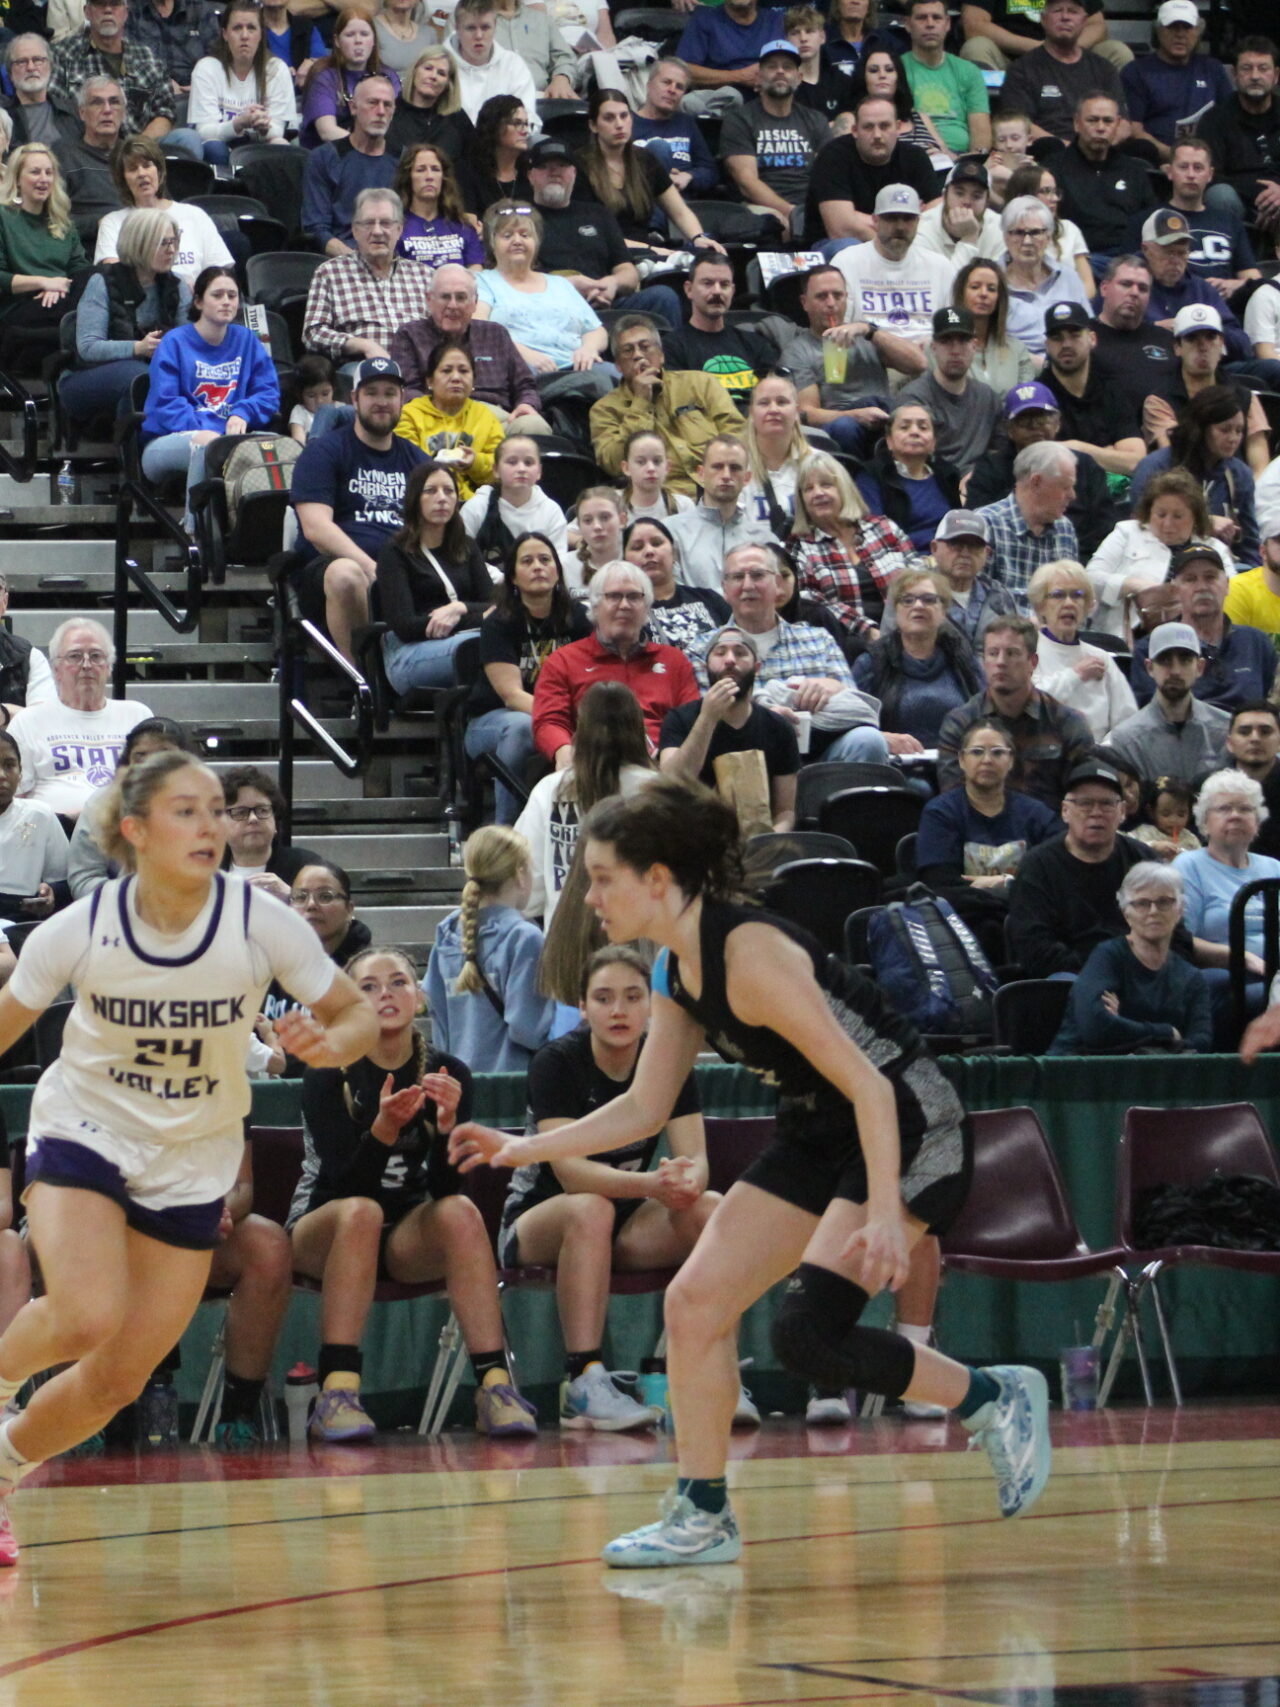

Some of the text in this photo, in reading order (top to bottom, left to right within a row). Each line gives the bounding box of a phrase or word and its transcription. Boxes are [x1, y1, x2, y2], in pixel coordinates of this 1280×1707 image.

[757, 129, 804, 142] JESUS.
[756, 141, 813, 155] FAMILY.
[862, 290, 932, 312] STATE
[947, 308, 961, 324] LA
[357, 467, 407, 487] LYNDEN
[348, 478, 407, 499] CHRISTI
[355, 510, 405, 527] LYNC
[52, 746, 123, 773] STAT
[90, 992, 247, 1028] NOOKSACK
[134, 1037, 204, 1068] 24
